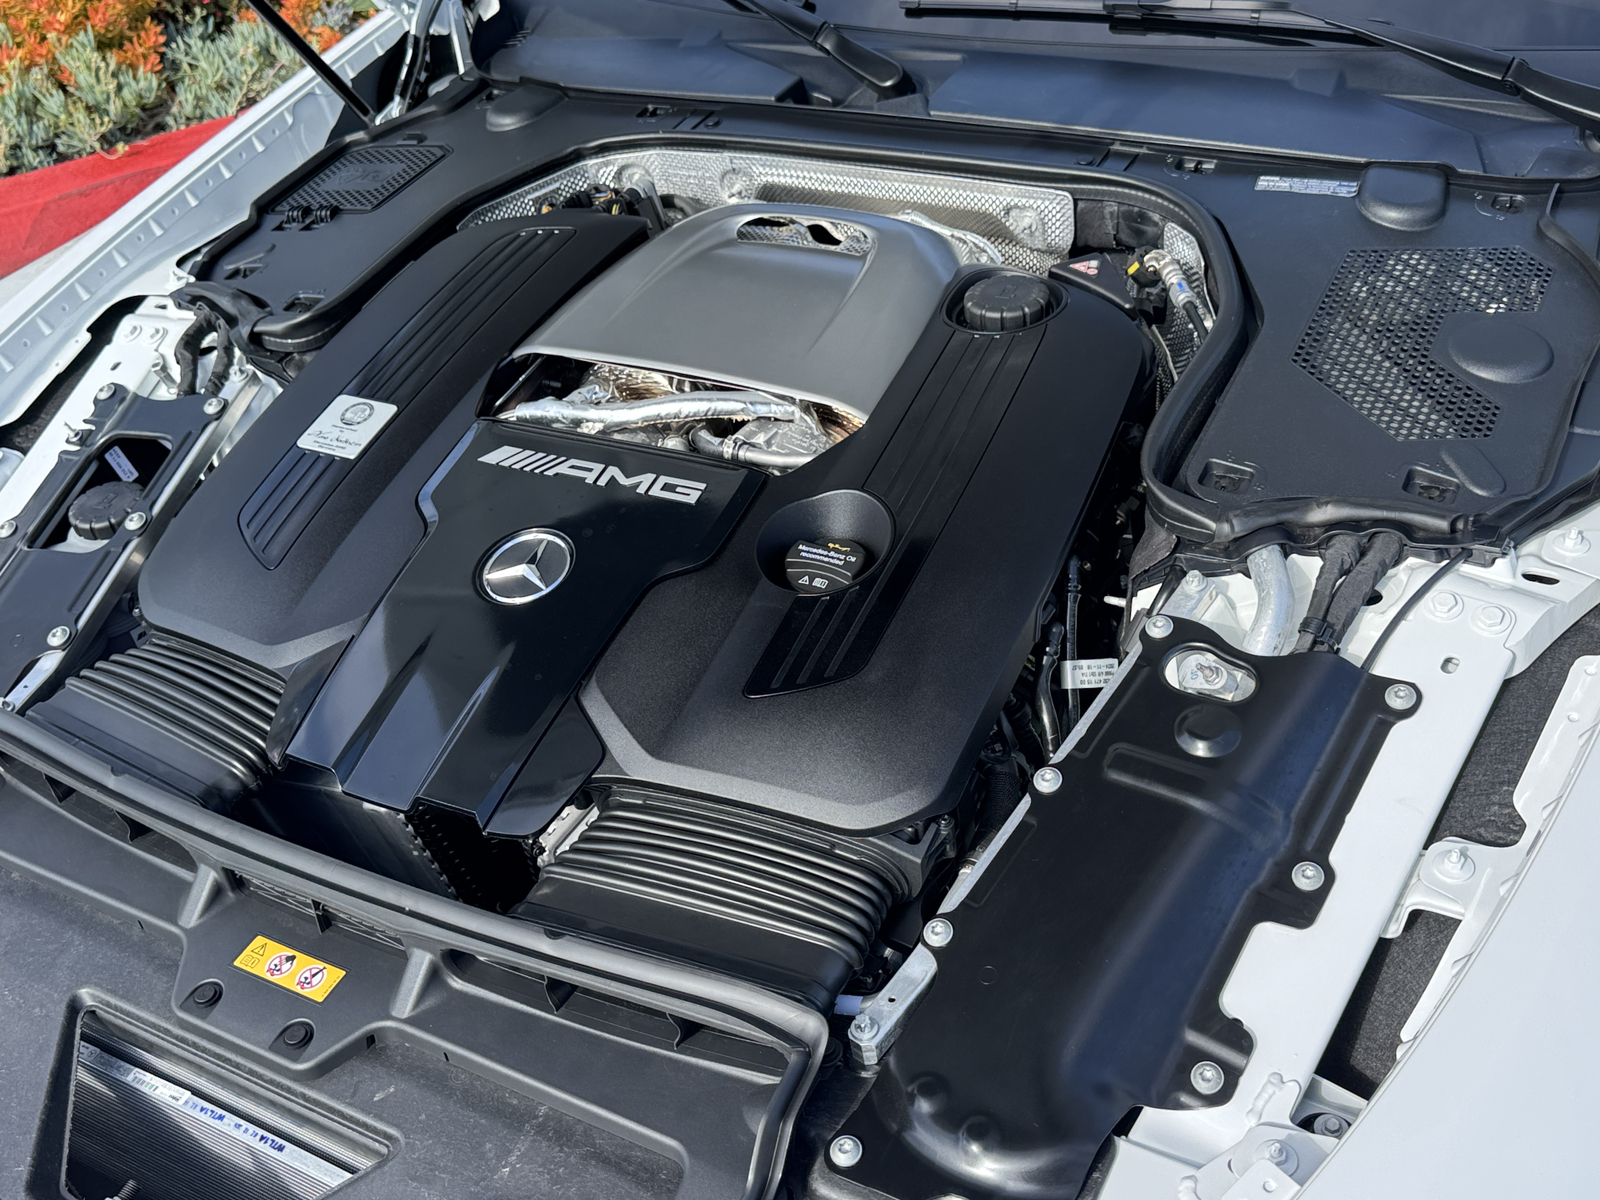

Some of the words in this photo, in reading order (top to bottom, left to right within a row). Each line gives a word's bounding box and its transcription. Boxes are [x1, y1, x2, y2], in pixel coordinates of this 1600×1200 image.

[544, 458, 707, 504] AMG
[797, 544, 846, 560] Mercedes-Benz
[800, 551, 845, 565] recommended
